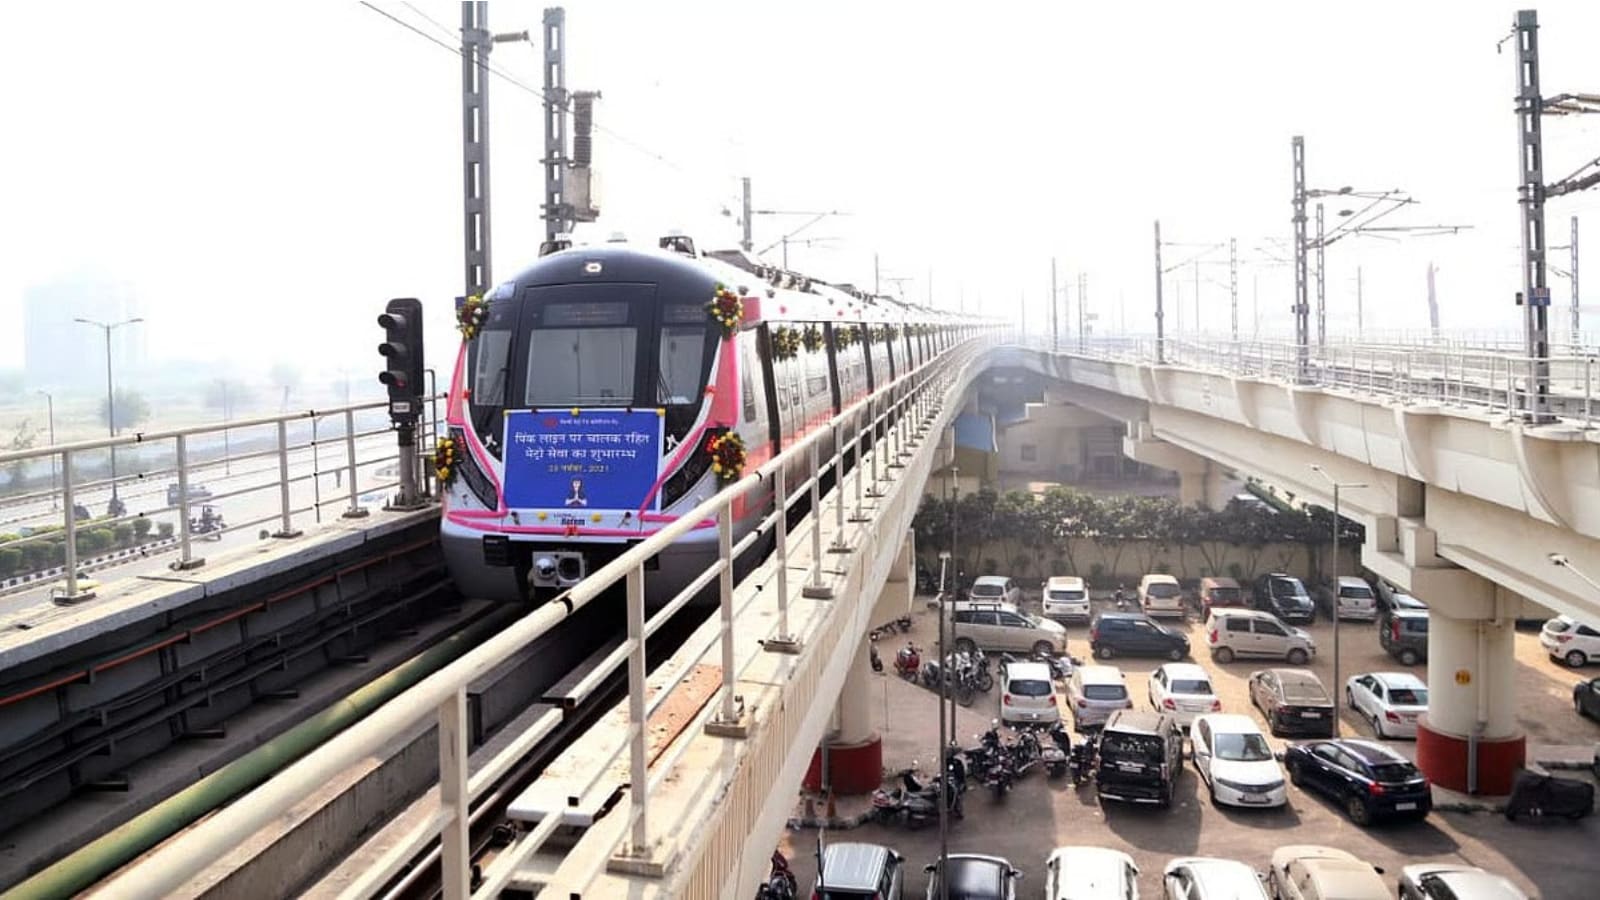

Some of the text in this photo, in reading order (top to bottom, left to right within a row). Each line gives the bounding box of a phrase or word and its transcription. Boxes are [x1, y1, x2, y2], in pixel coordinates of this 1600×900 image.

[514, 431, 650, 445] पिंक लाइन पर चालक रहित
[547, 446, 568, 459] सेवा
[571, 449, 587, 459] का
